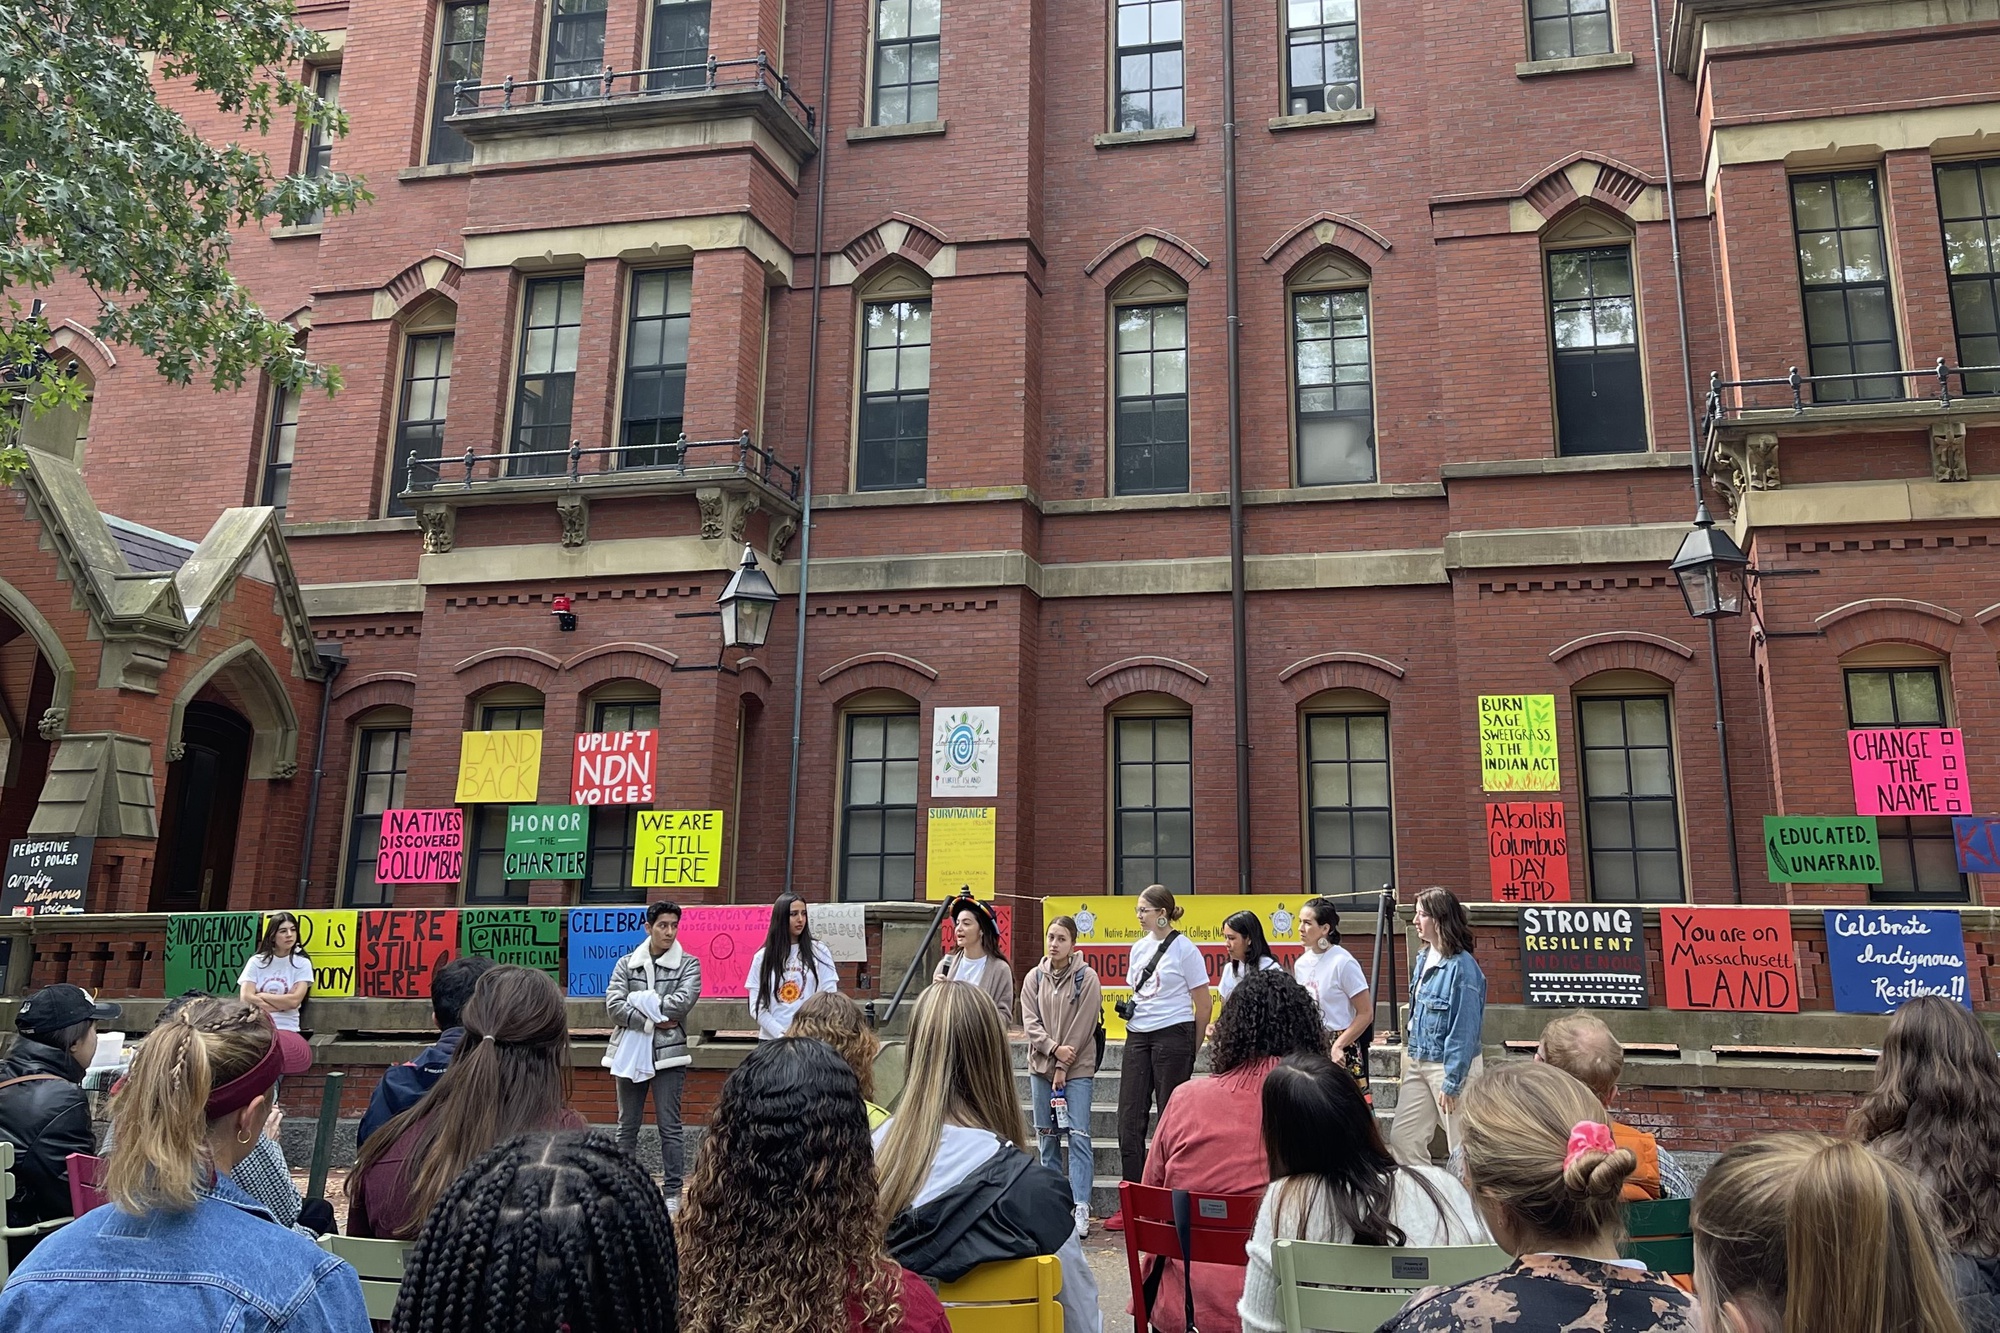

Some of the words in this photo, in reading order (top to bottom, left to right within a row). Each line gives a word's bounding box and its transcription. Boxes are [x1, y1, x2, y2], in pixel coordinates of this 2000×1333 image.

[1482, 698, 1522, 711] BURN
[466, 733, 537, 765] LAND
[578, 731, 651, 752] UPLIFT
[1485, 742, 1493, 756] &
[1496, 743, 1522, 755] THE
[1853, 732, 1932, 760] CHANGE
[579, 751, 650, 786] NDN
[1485, 758, 1528, 770] INDIAN
[1533, 758, 1557, 771] ACT
[1886, 760, 1922, 783] THE
[462, 765, 533, 799] BACK
[575, 784, 652, 805] VOICES
[1877, 783, 1939, 812] NAME
[390, 812, 462, 833] NATIVES
[511, 813, 580, 832] HONOR
[641, 814, 674, 830] WE
[679, 814, 713, 830] ARE
[929, 808, 988, 818] SURVIVANCE
[1491, 803, 1562, 829] Abolish
[380, 834, 460, 850] DISCOVERED
[538, 837, 556, 845] THE
[655, 835, 710, 855] STILL
[1491, 831, 1566, 857] Columbus
[1779, 827, 1870, 845] EDUCATED.
[12, 841, 70, 857] PERSPECTIVE
[30, 856, 40, 867] IS
[44, 853, 79, 867] POWER
[378, 851, 463, 879] COLUMBUS
[504, 851, 585, 875] CHARTER
[644, 857, 708, 883] HERE
[1510, 857, 1546, 881] DAY
[1791, 855, 1879, 873] UNAFRAID.
[1502, 881, 1554, 900] #IPD
[364, 910, 446, 942] WE'RE
[466, 911, 531, 924] DONATE
[541, 911, 557, 923] TO
[572, 911, 647, 933] CELEBRA
[680, 922, 740, 931] NDIGENOUS
[1524, 908, 1632, 934] STRONG
[1671, 914, 1715, 941] You
[1720, 927, 1746, 942] are
[1753, 927, 1778, 941] on
[1834, 912, 1931, 937] Celebrate
[176, 915, 254, 945] INDIGENOUS
[326, 919, 346, 948] is
[472, 927, 530, 949] @NAHC
[1104, 928, 1123, 938] Native
[1189, 927, 1211, 940] College
[583, 945, 637, 960] INDIGEN
[1525, 935, 1634, 951] RESILIENT
[365, 941, 428, 973] STILL
[498, 950, 559, 965] OFFICIAL
[833, 950, 858, 960] ay
[1527, 955, 1642, 971] INDIGENOUS
[1671, 942, 1793, 968] Massachusett
[1856, 944, 1963, 974] Indigenous
[364, 968, 421, 996] HERE
[569, 972, 611, 995] RESIL
[712, 986, 737, 994] DAY
[1685, 969, 1790, 1008] LAND
